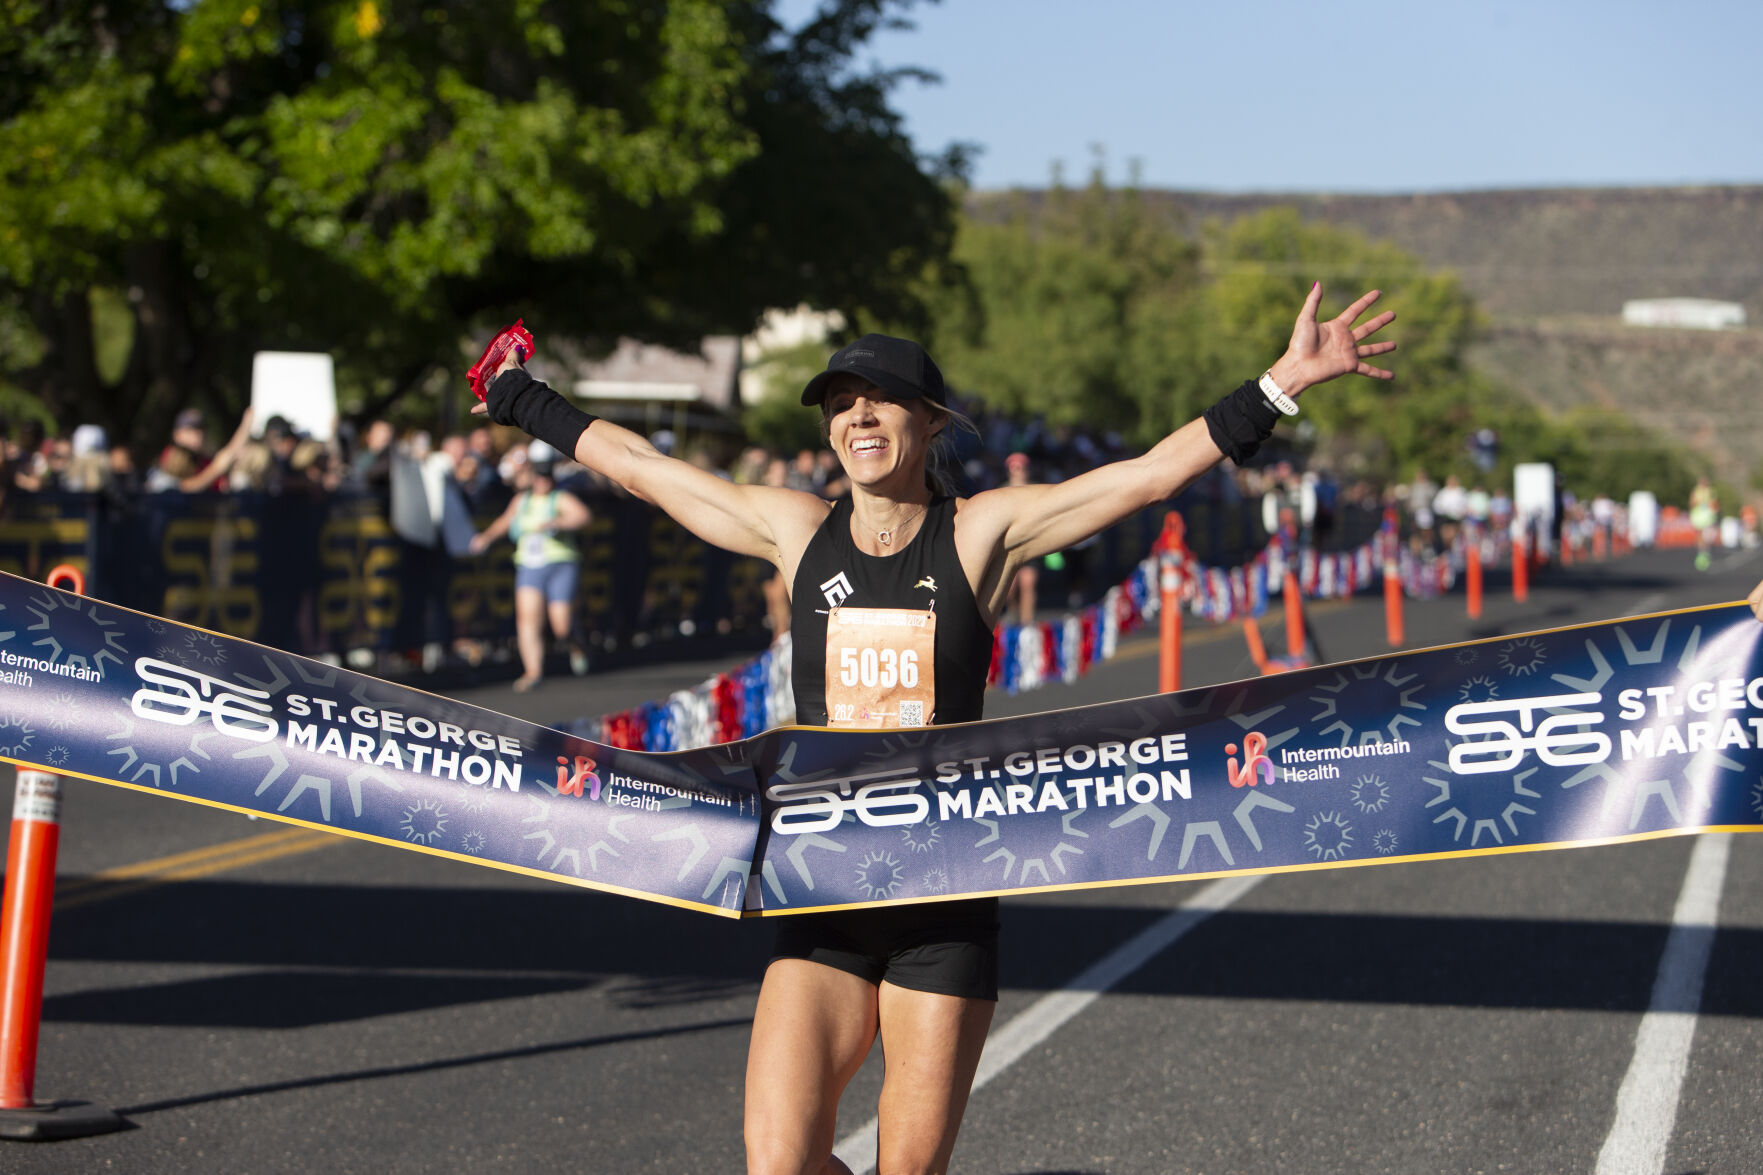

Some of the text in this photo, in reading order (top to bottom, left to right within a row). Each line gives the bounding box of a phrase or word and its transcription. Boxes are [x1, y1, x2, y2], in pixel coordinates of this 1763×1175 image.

[840, 647, 919, 689] 5036
[286, 694, 523, 757] ST.GEORGE
[285, 720, 522, 792] MARATHON
[935, 733, 1189, 783] ST.GEORGE
[1281, 738, 1411, 764] Intermountain
[609, 772, 732, 808] Intermountain
[1282, 764, 1341, 783] Health
[607, 788, 661, 812] Health
[937, 769, 1192, 821] MARATHON
